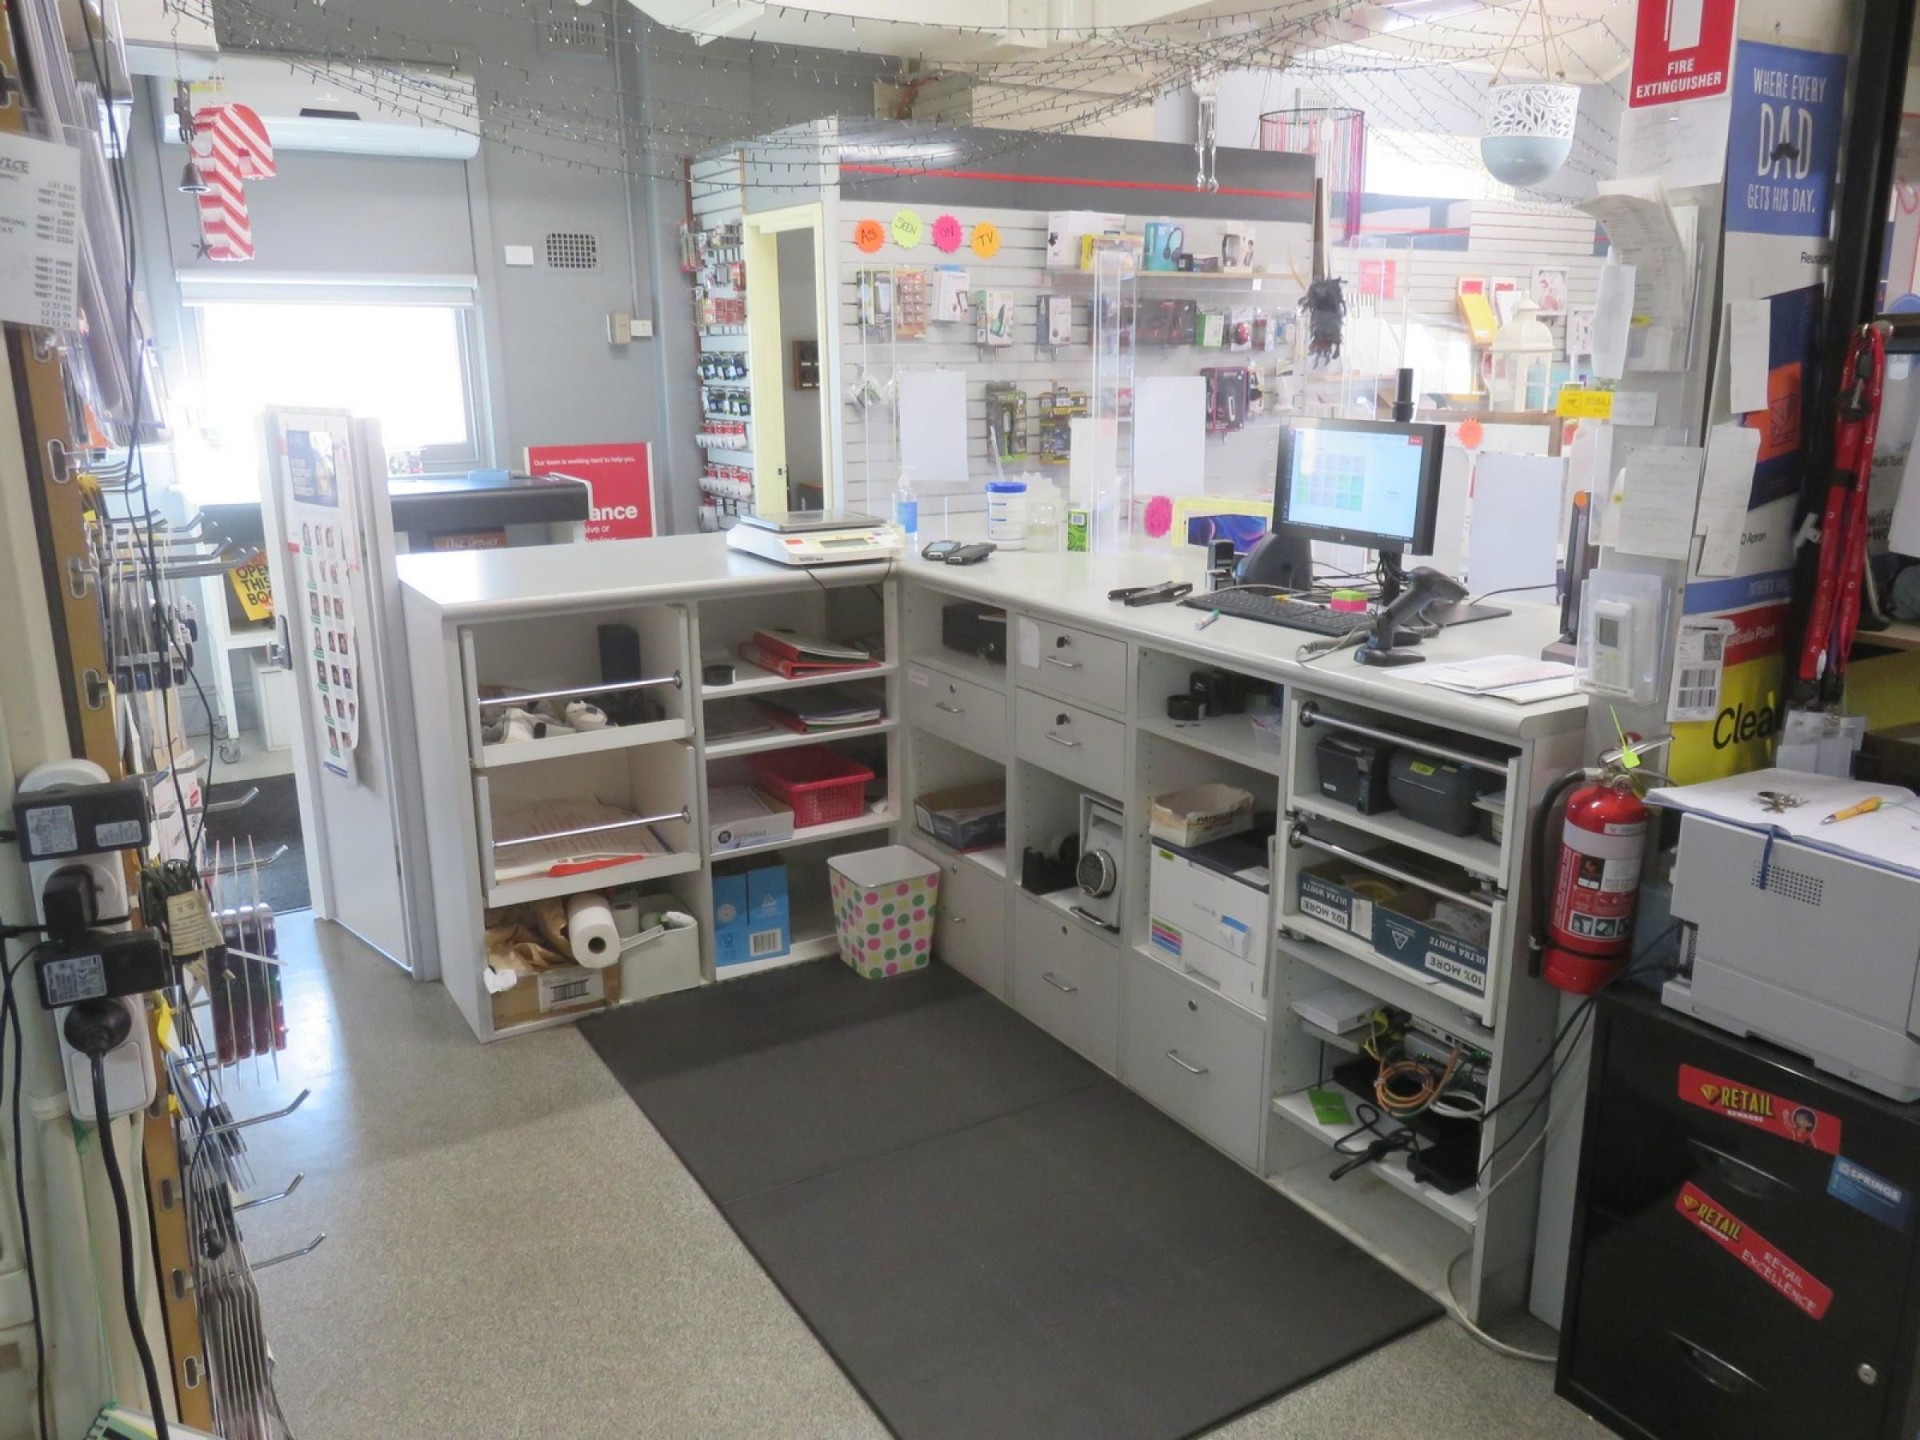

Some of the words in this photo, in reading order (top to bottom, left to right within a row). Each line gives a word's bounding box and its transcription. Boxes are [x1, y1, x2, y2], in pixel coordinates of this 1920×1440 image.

[1667, 58, 1695, 76] FIRE
[1636, 71, 1722, 98] EXTINGUISHER
[1753, 67, 1789, 99] WHERE
[1791, 75, 1827, 103] EVERY
[1758, 102, 1813, 180] DAD
[1747, 183, 1770, 211] GETS
[1772, 186, 1789, 212] HIS
[1792, 188, 1815, 213] DAY.
[861, 228, 877, 244] AS
[894, 217, 918, 235] SEEN
[940, 225, 954, 238] ON
[977, 232, 993, 247] TV
[591, 505, 638, 521] ance
[240, 577, 271, 592] THIS
[1303, 882, 1325, 897] WHITE
[1326, 891, 1348, 906] ULTRA
[1303, 900, 1329, 916] MORE
[1331, 911, 1346, 925] 10%
[1429, 936, 1457, 954] WHITE
[1430, 956, 1461, 976] MORE
[1458, 947, 1486, 966] ULTRA
[1464, 970, 1482, 986] 10%
[1721, 1087, 1773, 1116] RETAIL
[1696, 1204, 1741, 1240] RETAIL
[1763, 1252, 1804, 1288] RETAIL
[1741, 1249, 1817, 1313] EXCELLENCE
